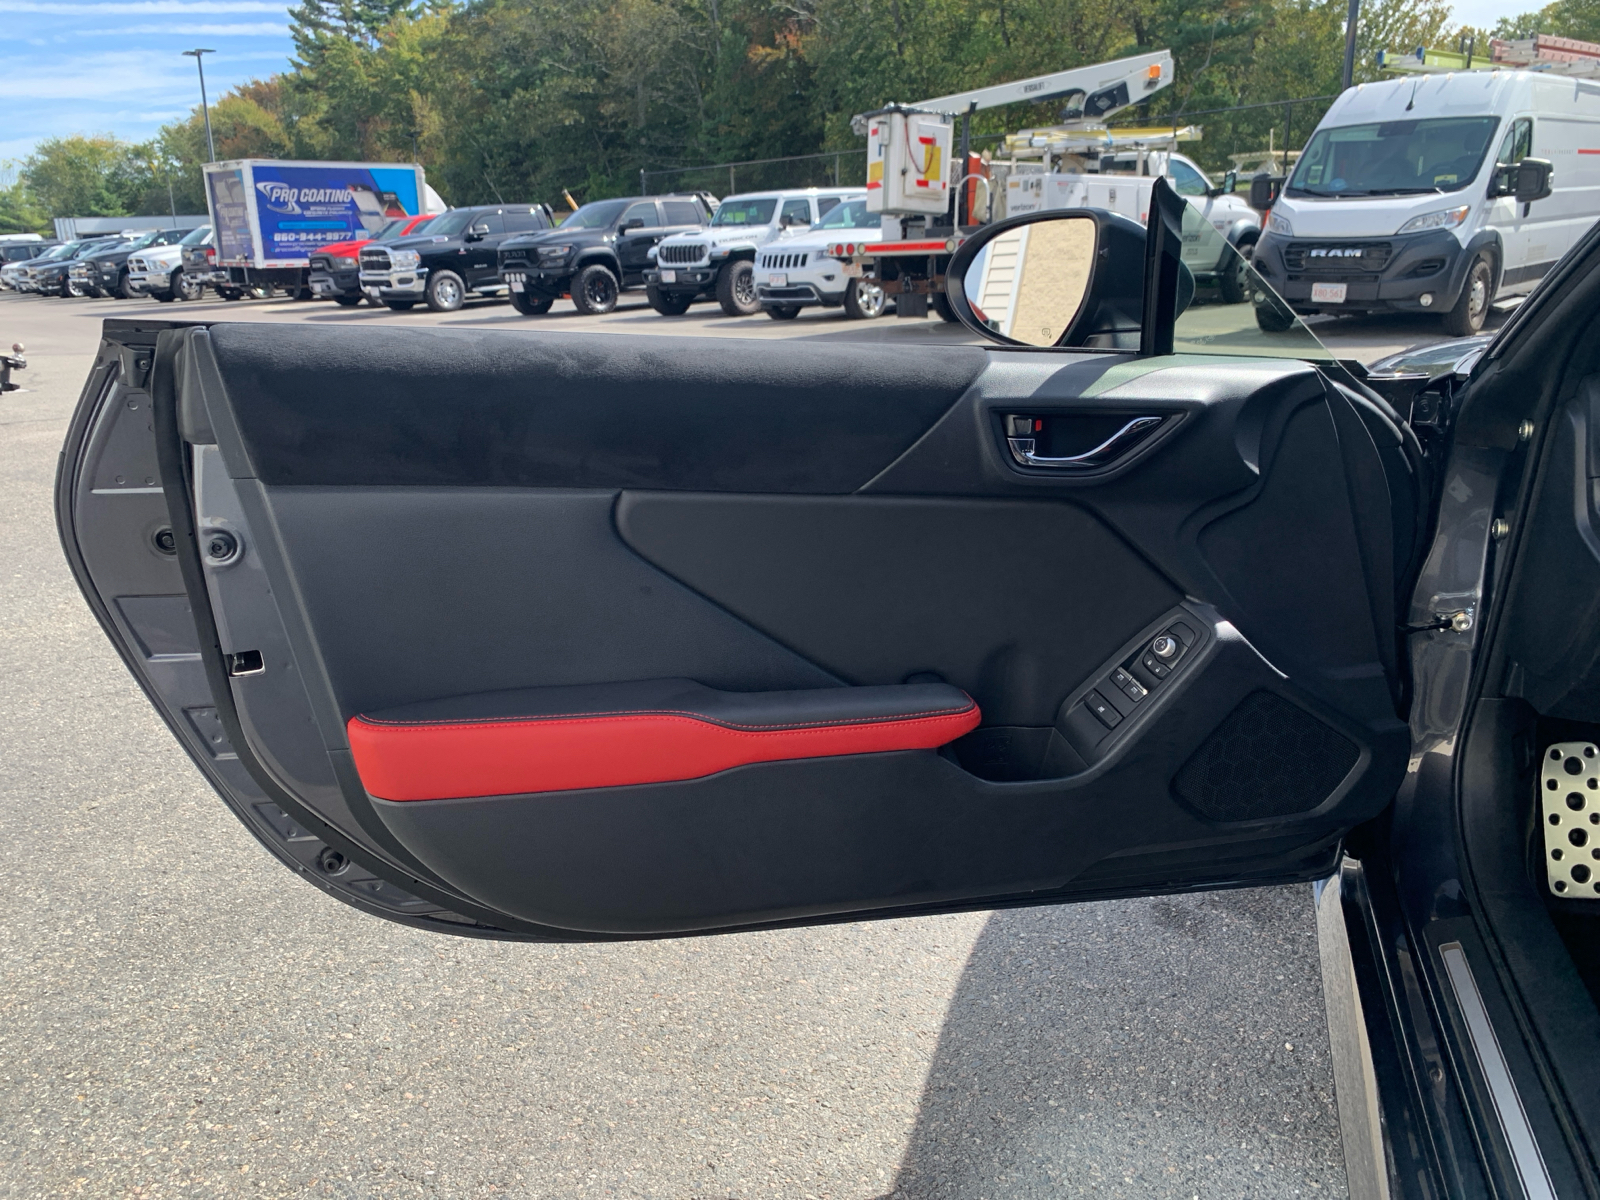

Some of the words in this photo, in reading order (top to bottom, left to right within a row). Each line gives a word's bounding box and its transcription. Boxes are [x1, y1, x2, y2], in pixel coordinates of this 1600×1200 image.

[271, 188, 298, 202] PRO
[299, 188, 352, 202] COATING
[1010, 203, 1035, 211] verizon
[1311, 249, 1362, 257] RAM
